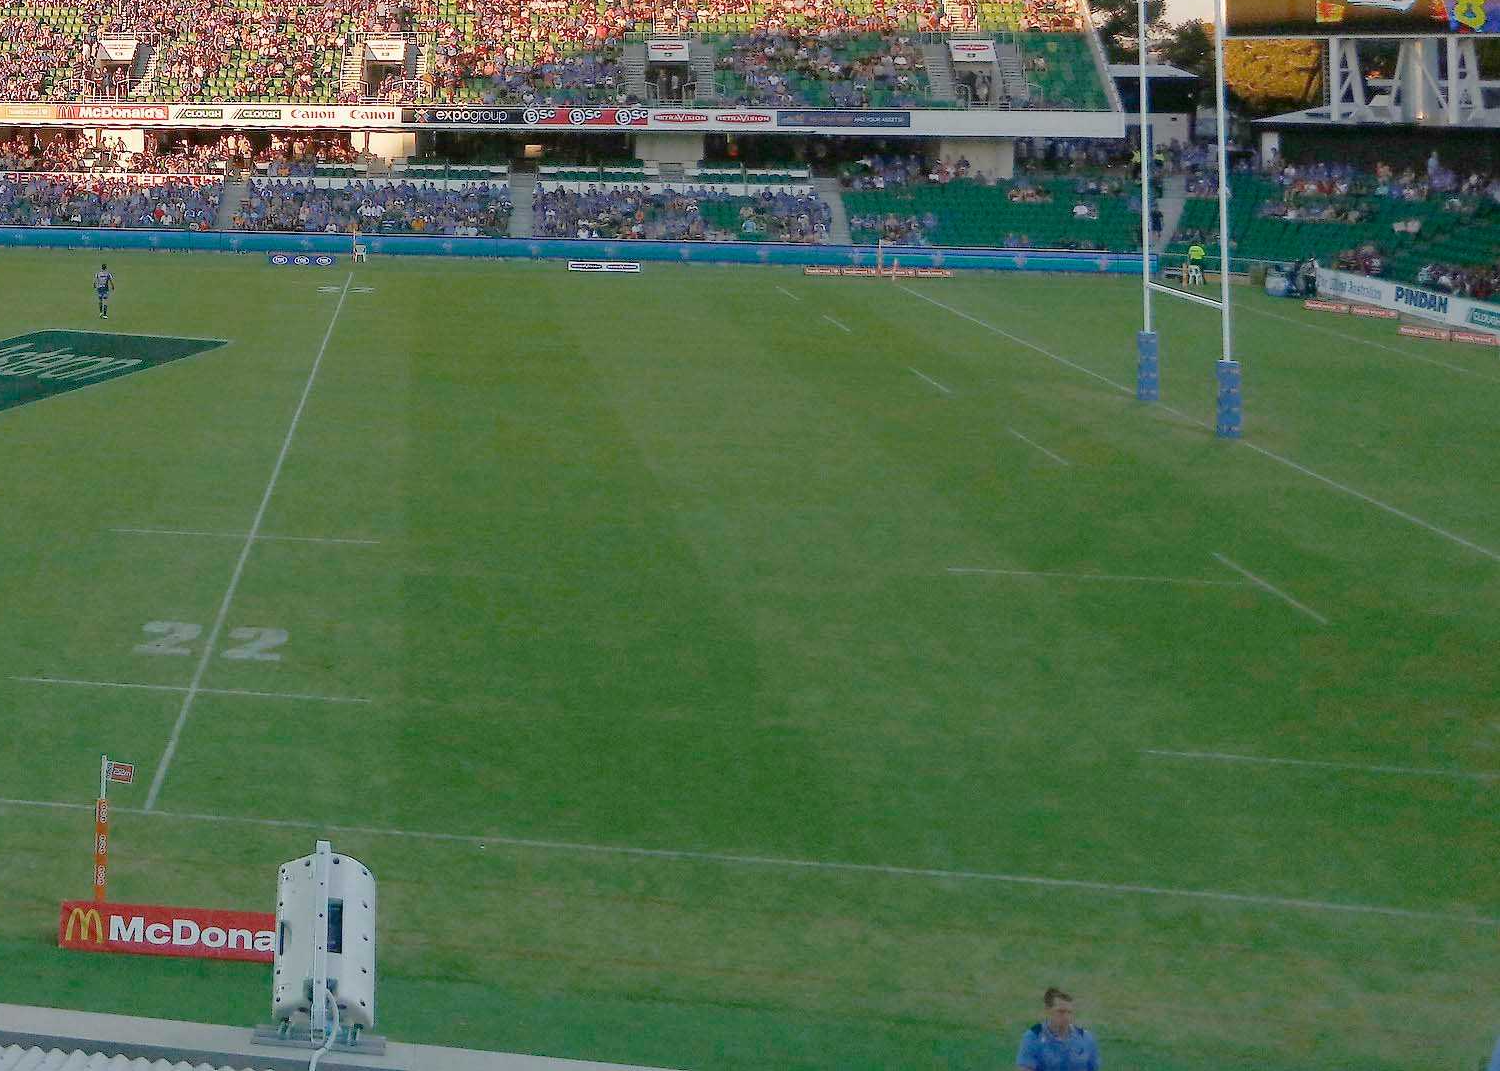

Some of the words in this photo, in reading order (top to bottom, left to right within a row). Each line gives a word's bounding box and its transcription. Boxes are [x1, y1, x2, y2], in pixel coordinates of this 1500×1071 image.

[79, 106, 164, 119] McDonald's
[185, 109, 221, 118] CLOUGH
[243, 110, 280, 119] CLOUGH
[290, 109, 335, 119] Canon
[350, 109, 395, 120] Canon
[435, 110, 508, 124] expogroup
[132, 621, 289, 661] 22
[109, 915, 275, 952] McDona
